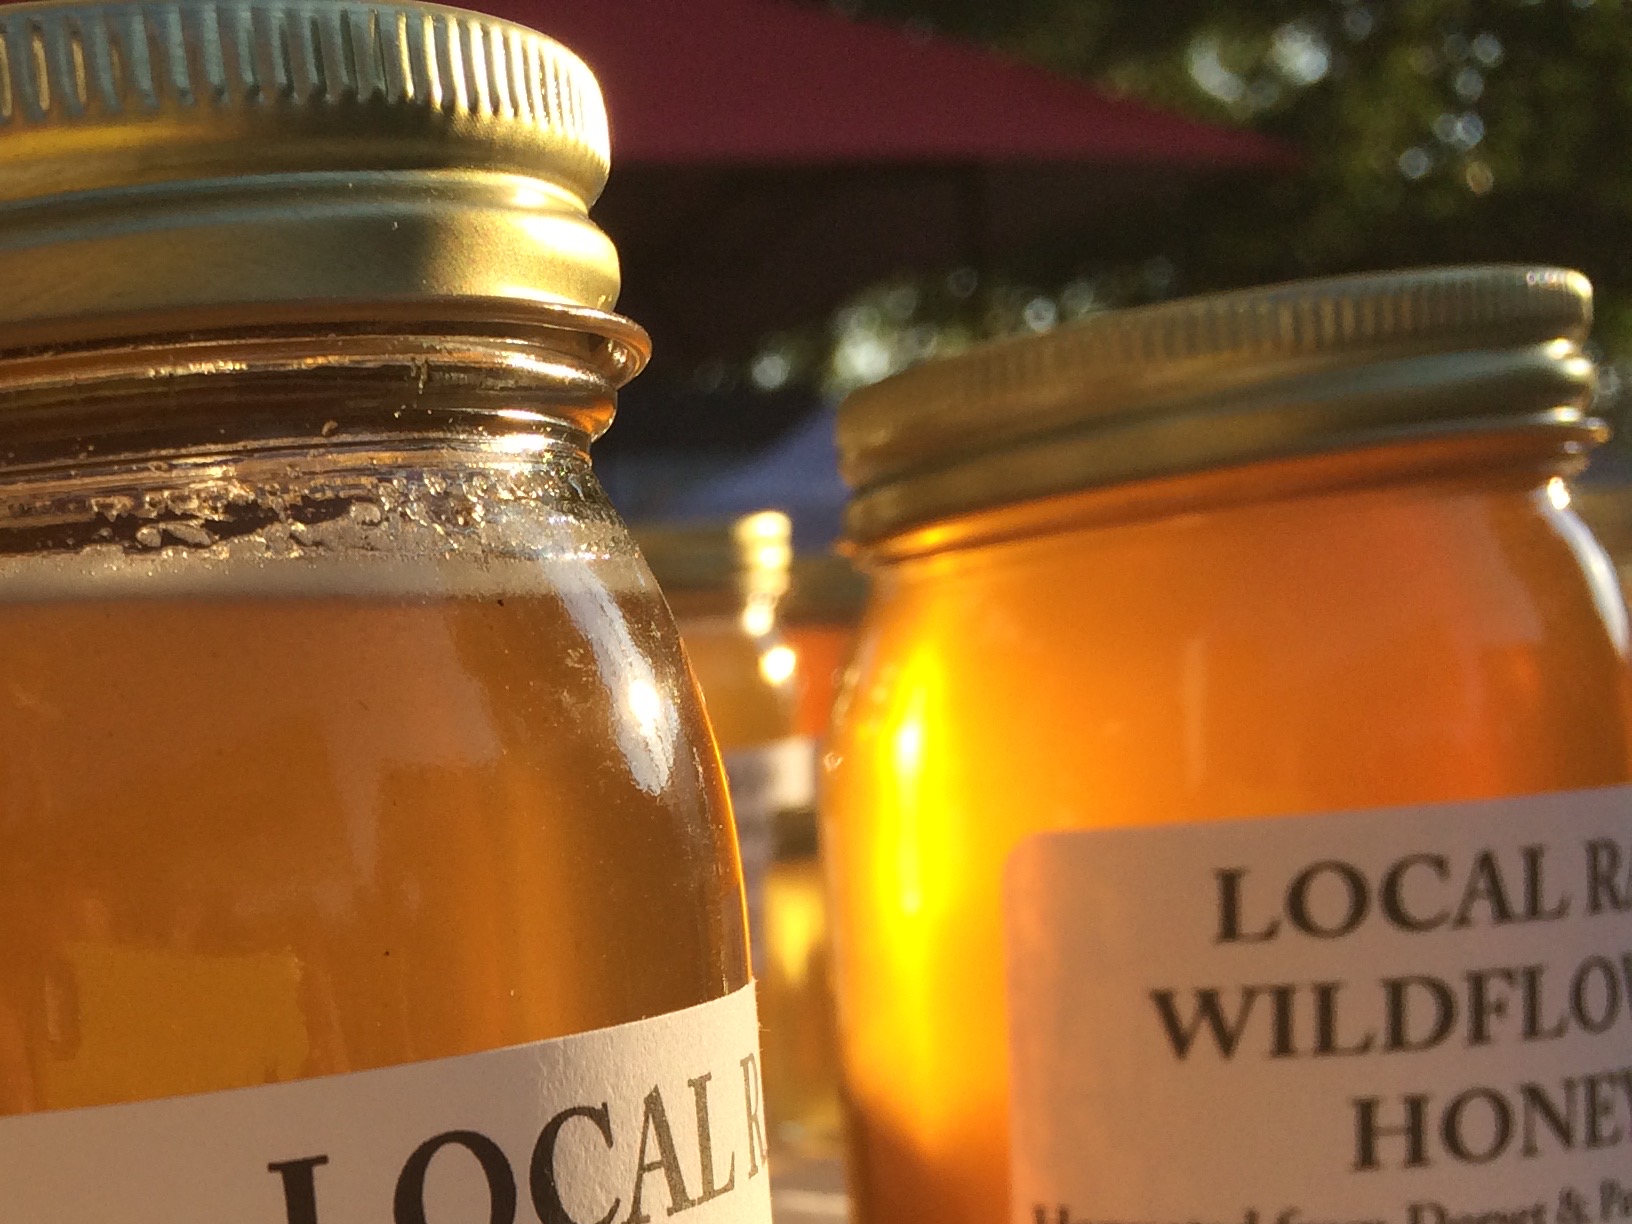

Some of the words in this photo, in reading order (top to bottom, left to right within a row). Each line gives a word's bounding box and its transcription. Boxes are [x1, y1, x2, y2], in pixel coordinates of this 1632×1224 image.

[1213, 841, 1570, 945] LOCAL
[1584, 835, 1632, 916] R
[1148, 948, 1632, 1062] WILDFLO
[1350, 1067, 1632, 1174] HONE
